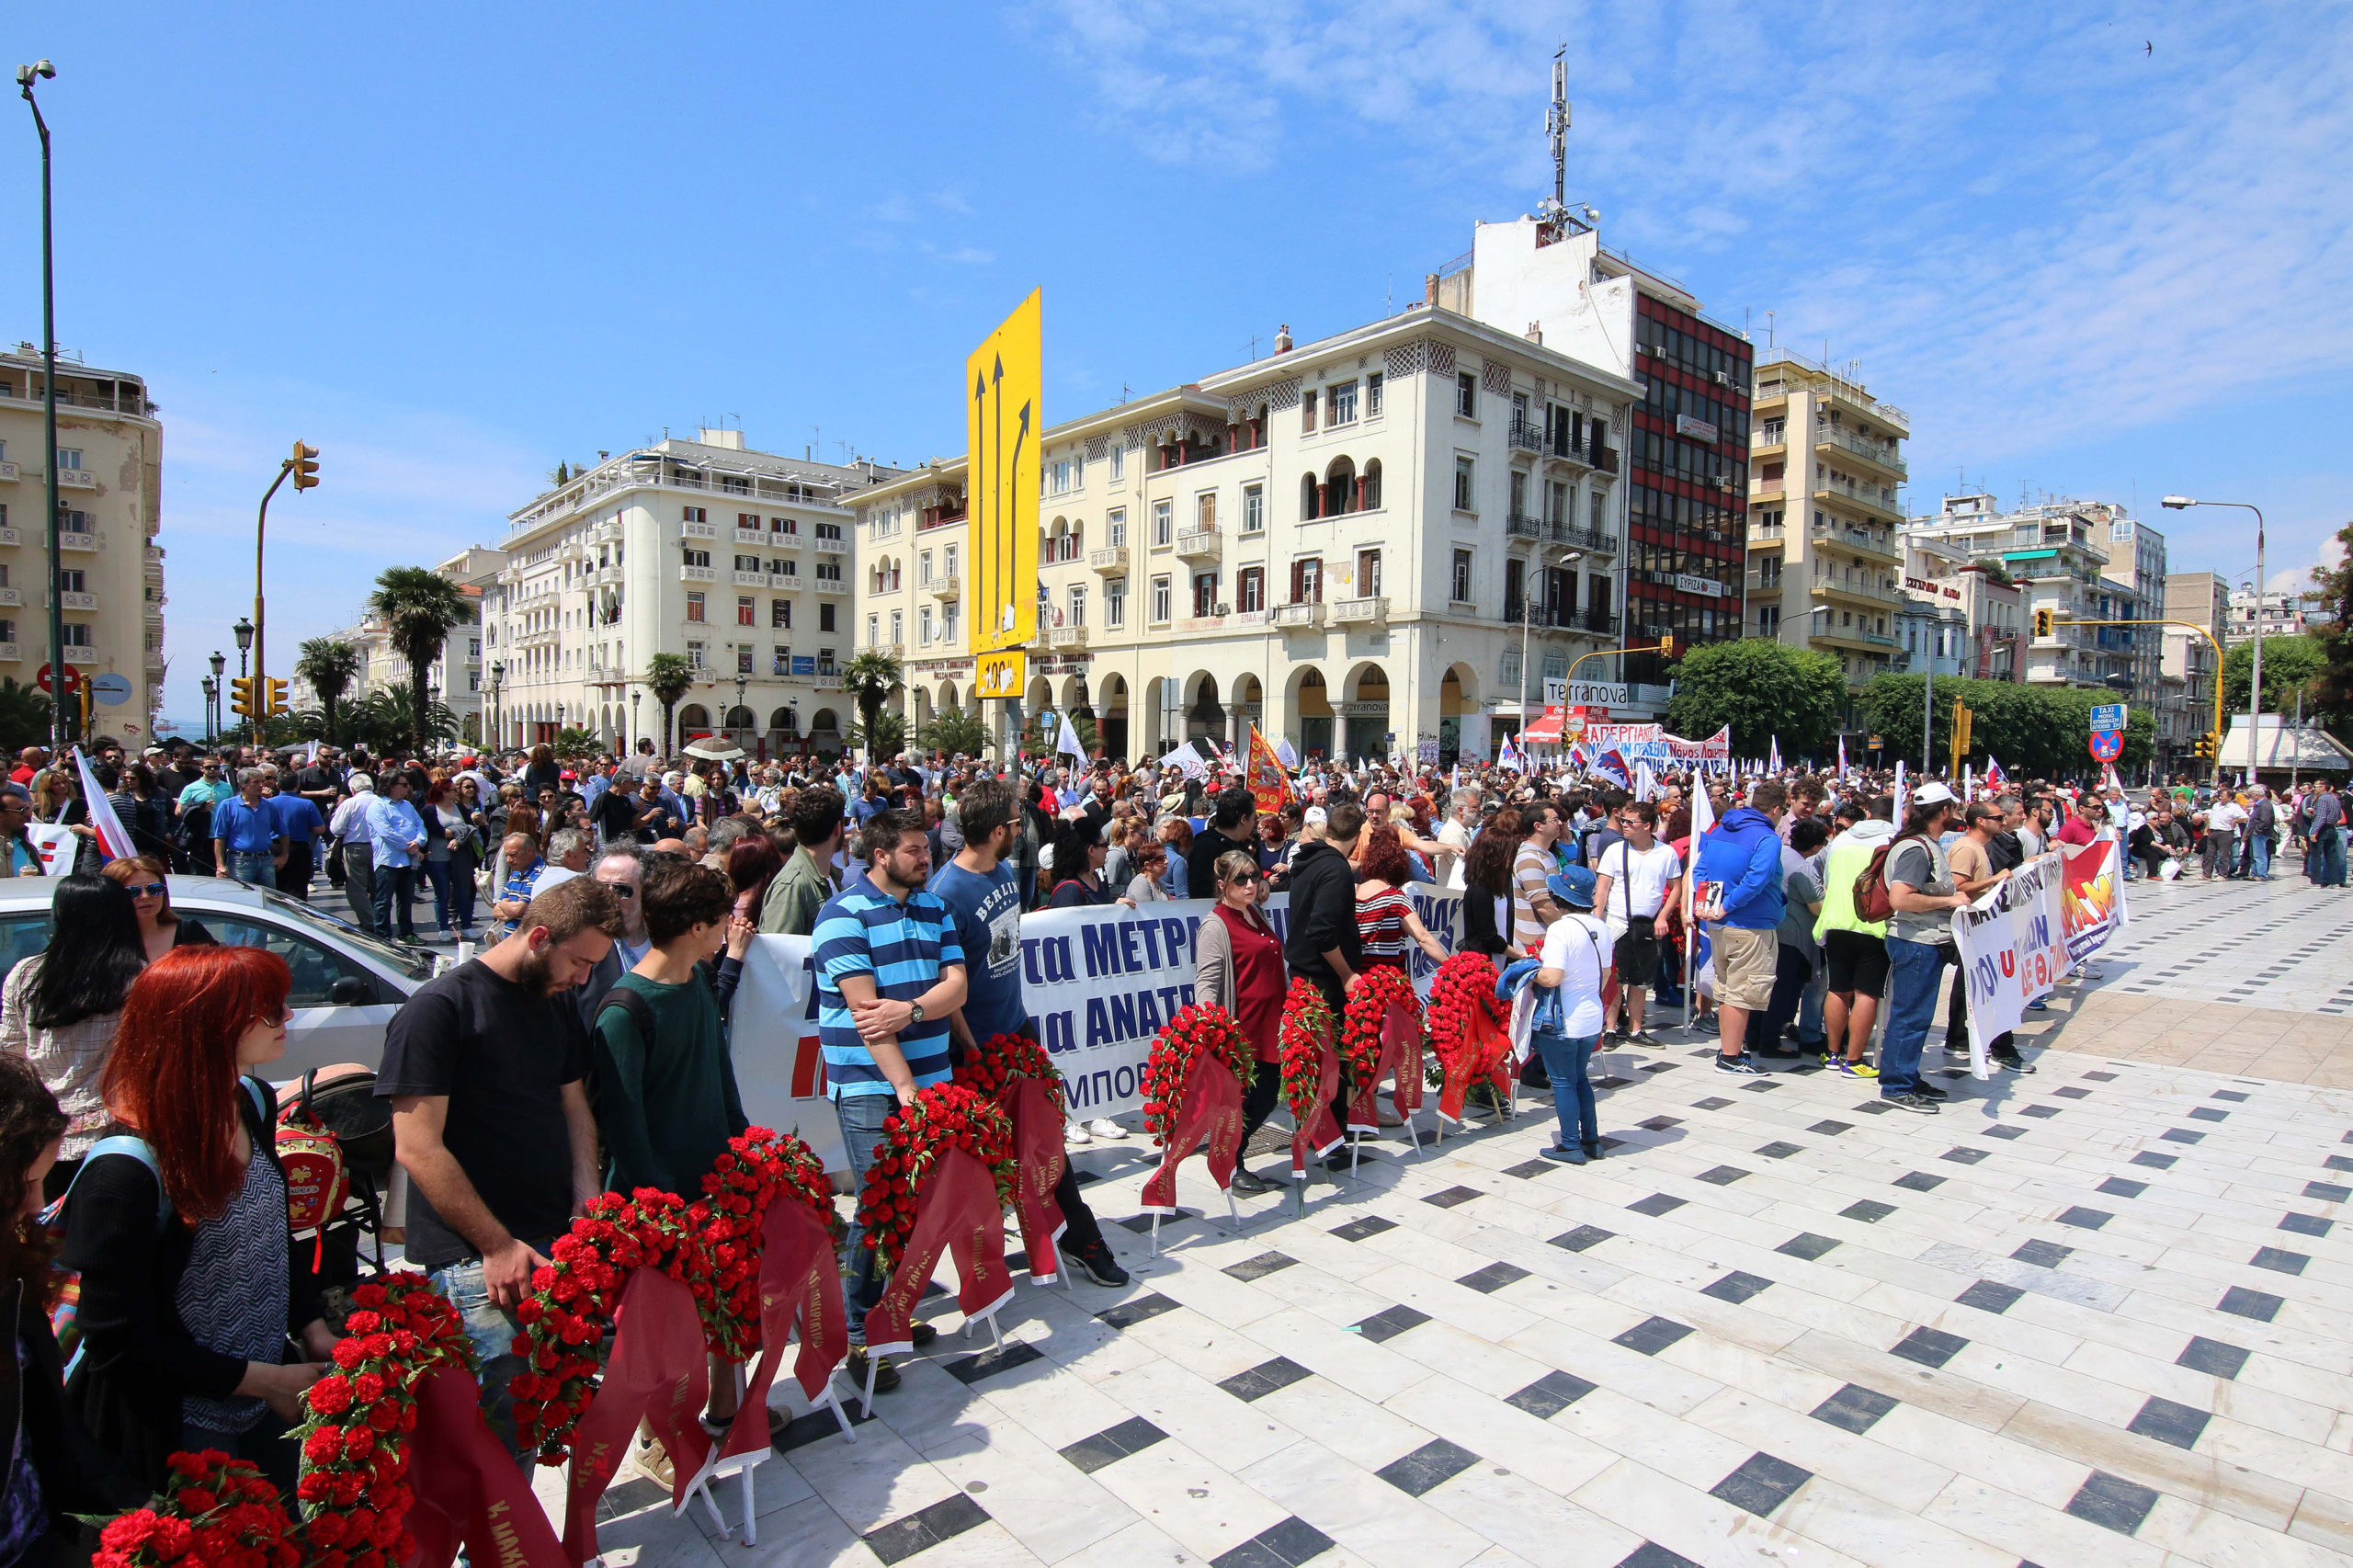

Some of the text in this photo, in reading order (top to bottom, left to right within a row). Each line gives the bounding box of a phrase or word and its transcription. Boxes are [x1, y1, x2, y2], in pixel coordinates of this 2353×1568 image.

[1679, 576, 1701, 592] ΣΥΡΙΖΑ
[2099, 706, 2114, 714] TAXI
[975, 881, 1018, 923] BERLIN
[1029, 1010, 1077, 1054] ια
